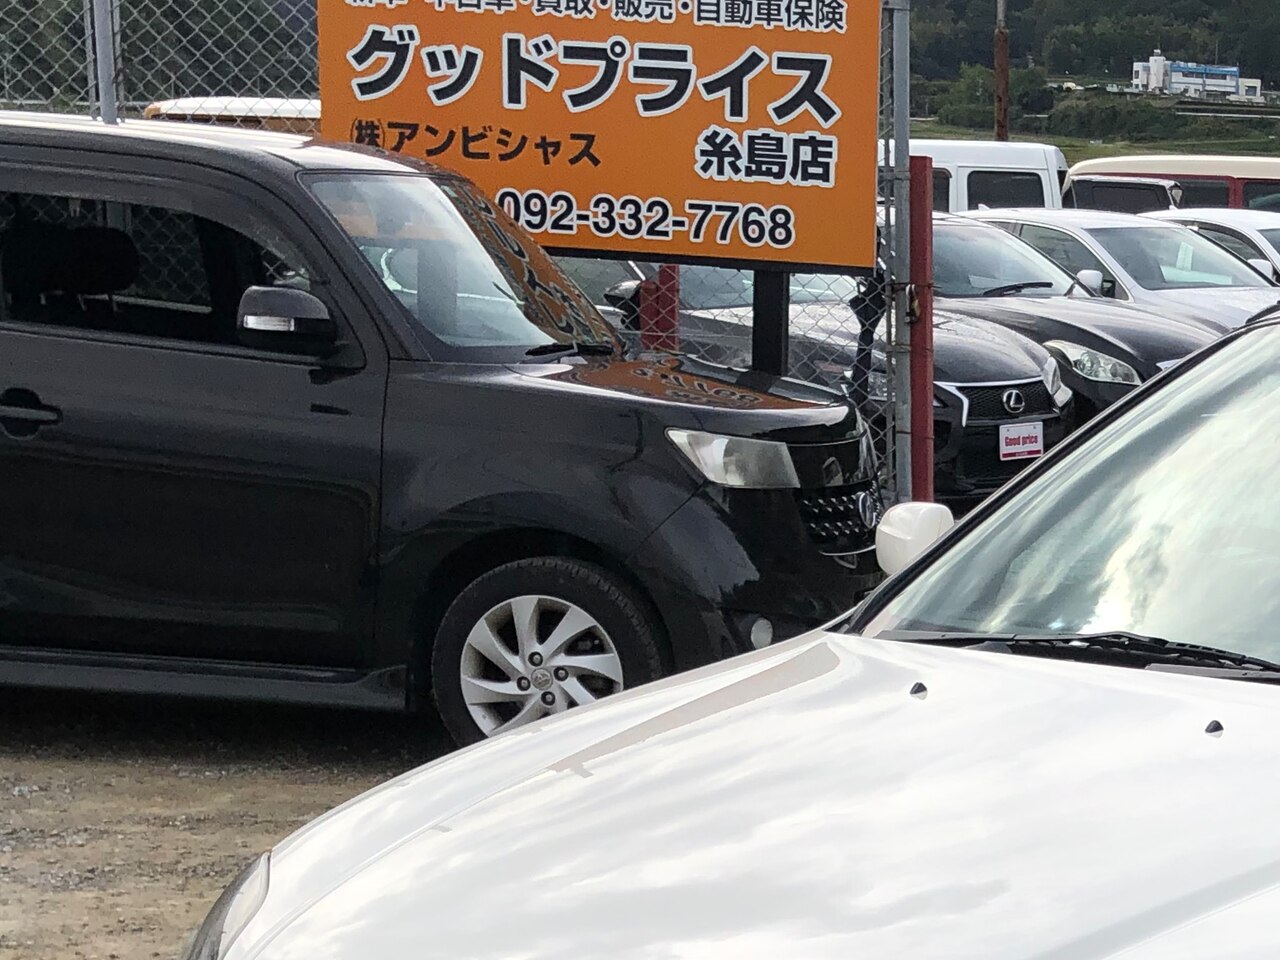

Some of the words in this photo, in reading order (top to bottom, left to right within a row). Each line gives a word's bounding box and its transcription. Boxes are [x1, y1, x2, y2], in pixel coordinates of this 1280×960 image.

[348, 25, 841, 126] グッドプライス
[696, 126, 836, 187] 糸島店
[496, 189, 794, 247] 092-332-7768
